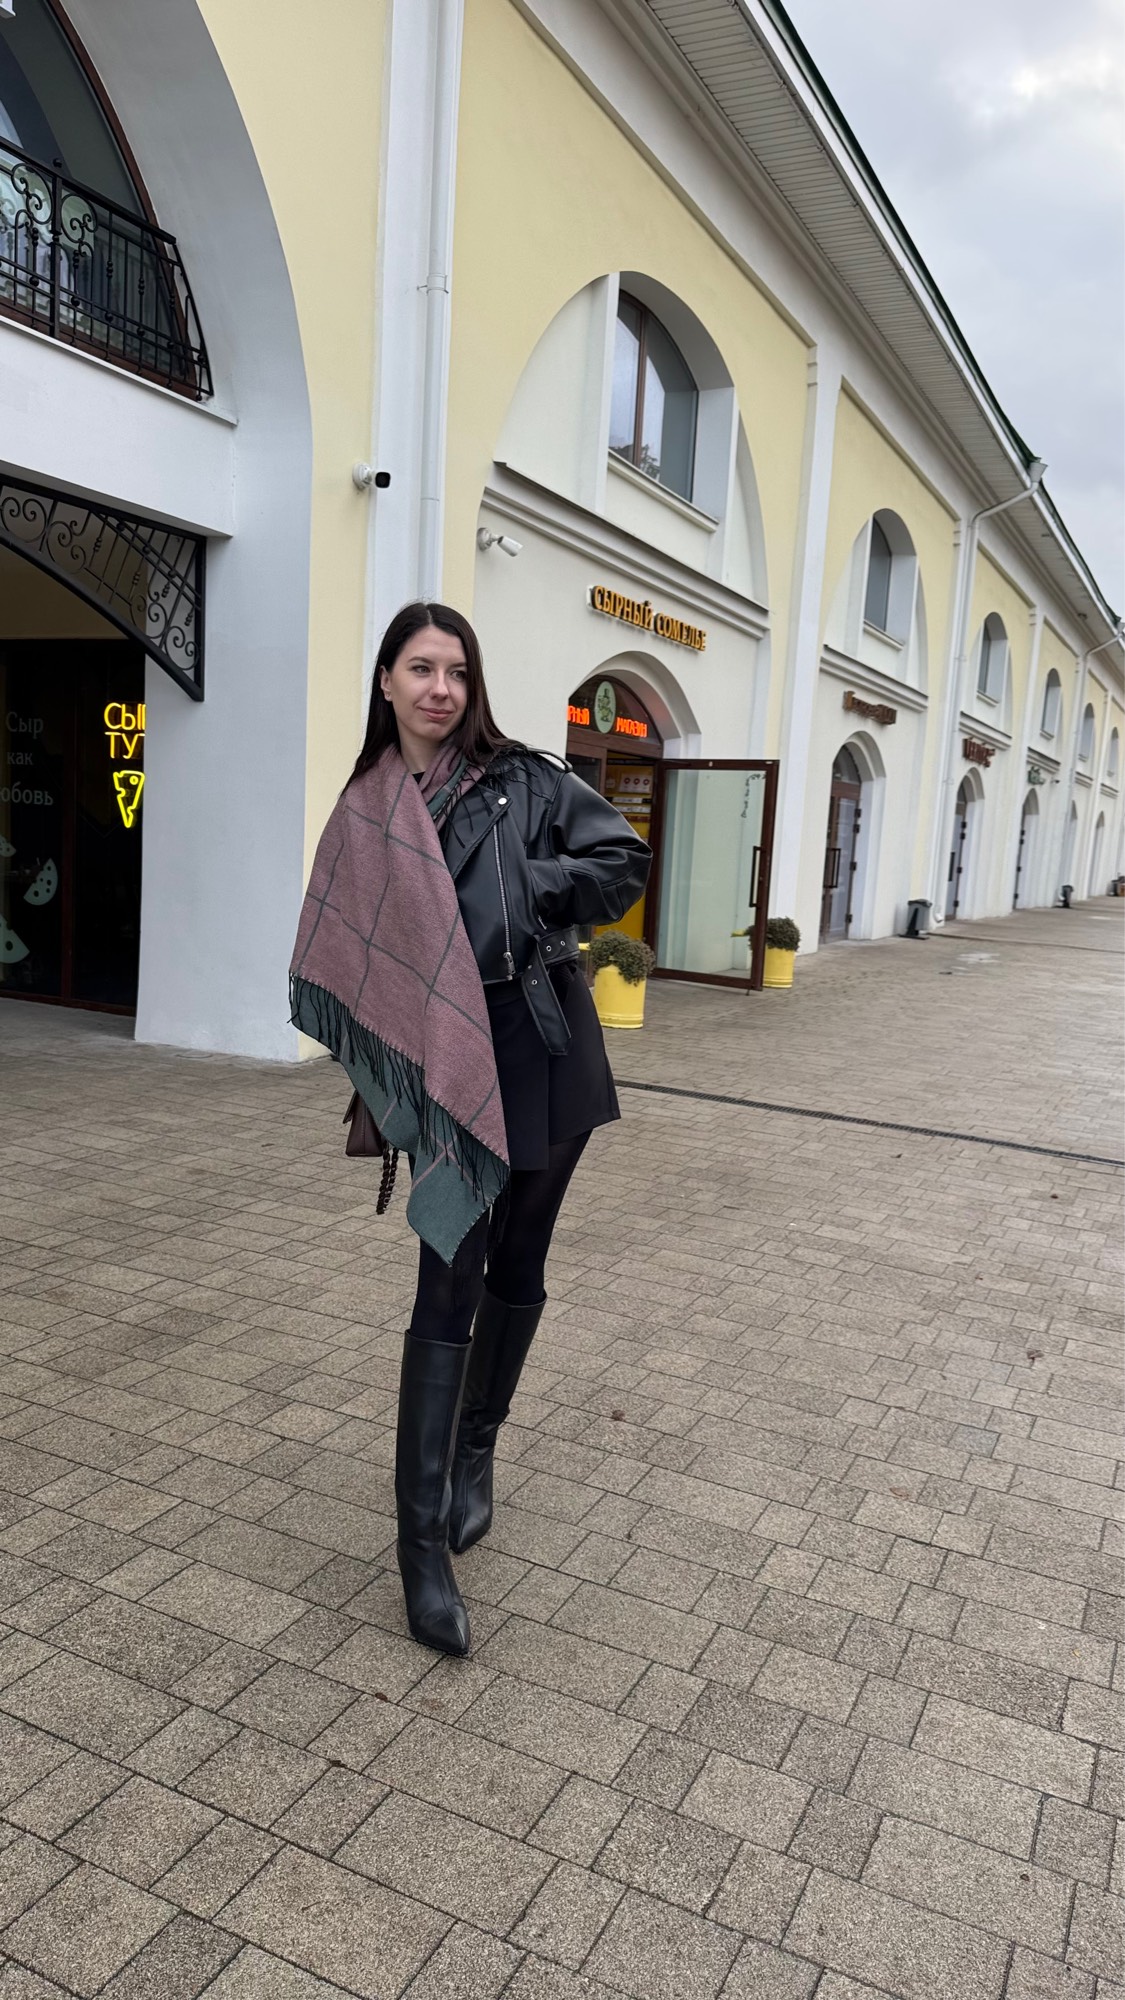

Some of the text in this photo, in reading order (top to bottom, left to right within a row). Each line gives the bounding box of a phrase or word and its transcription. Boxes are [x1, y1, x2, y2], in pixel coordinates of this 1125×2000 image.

[593, 585, 707, 651] СЫРНЫЙ СОМЕЛЬЕ
[5, 711, 44, 739] Сыр
[567, 705, 647, 738] РНЫЙ МАГАЗИН
[7, 751, 33, 765] как
[104, 731, 146, 759] ТУ
